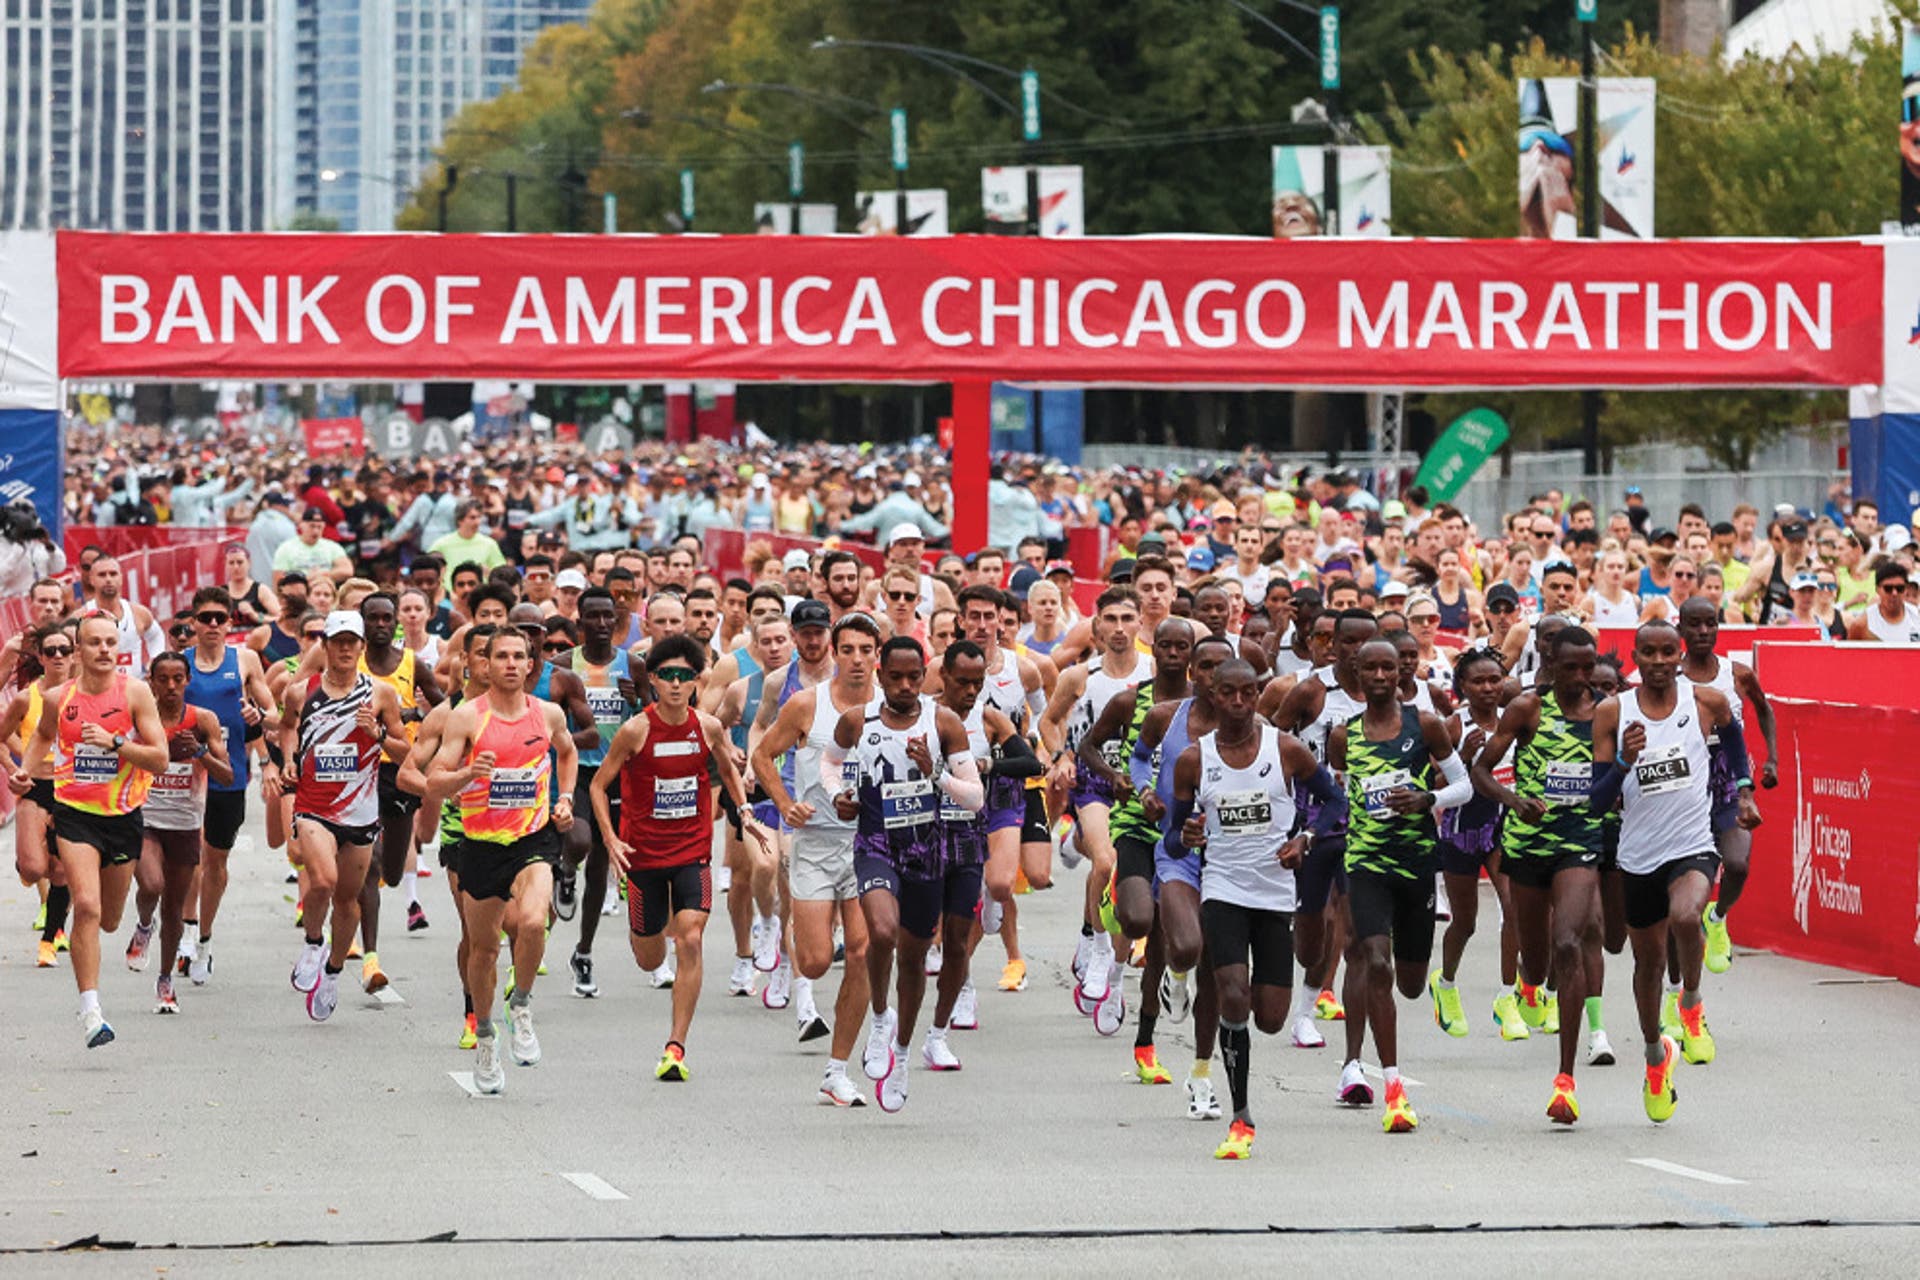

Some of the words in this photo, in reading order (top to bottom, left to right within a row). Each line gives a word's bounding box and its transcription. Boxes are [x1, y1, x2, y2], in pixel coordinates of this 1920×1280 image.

[100, 274, 341, 344] BANK
[365, 273, 481, 345] OF
[499, 275, 897, 346] AMERICA
[921, 276, 1306, 349] CHICAGO
[1337, 280, 1833, 352] MARATHON
[387, 420, 411, 448] B
[422, 424, 449, 453] A
[319, 757, 354, 769] YASUI
[1639, 762, 1675, 780] PACE
[1679, 759, 1687, 772] 1
[656, 792, 696, 804] HOSOYA
[895, 797, 922, 811] ESA
[1221, 806, 1257, 821] PACE
[1260, 804, 1270, 818] 2
[1814, 813, 1851, 870] Chicago
[1814, 867, 1863, 915] Marathon
